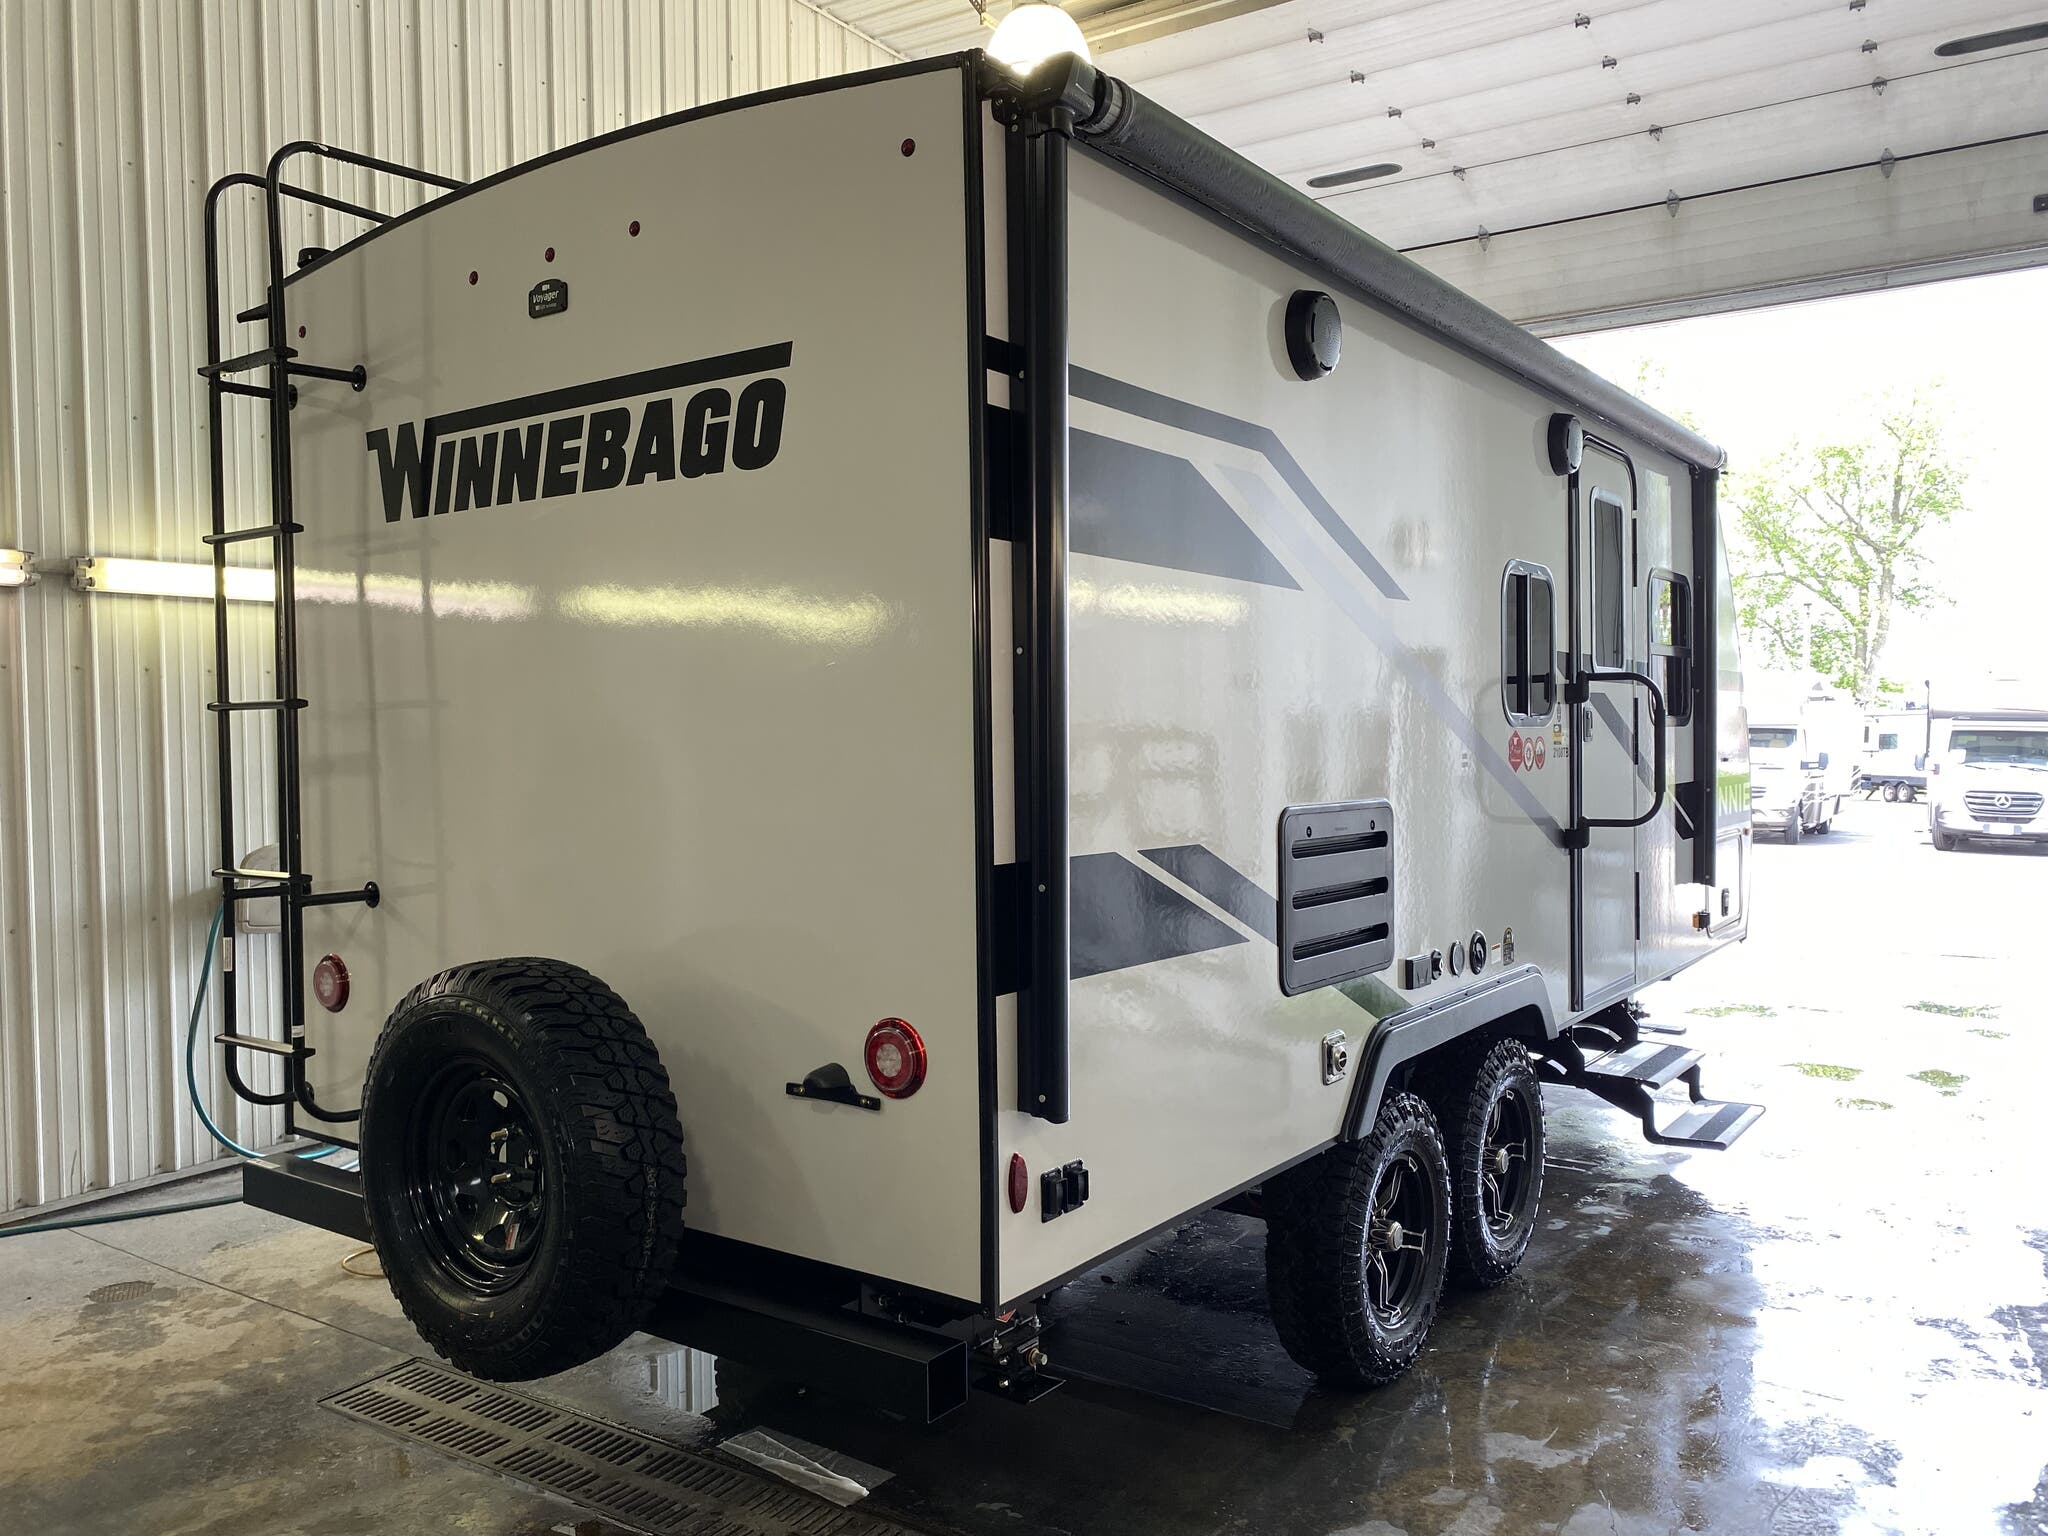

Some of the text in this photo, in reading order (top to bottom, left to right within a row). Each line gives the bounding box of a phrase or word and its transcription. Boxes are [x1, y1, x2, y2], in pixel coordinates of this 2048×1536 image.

[532, 290, 559, 303] Voyager
[366, 341, 793, 523] WINNEBAGO
[1718, 782, 1751, 816] NNIE
